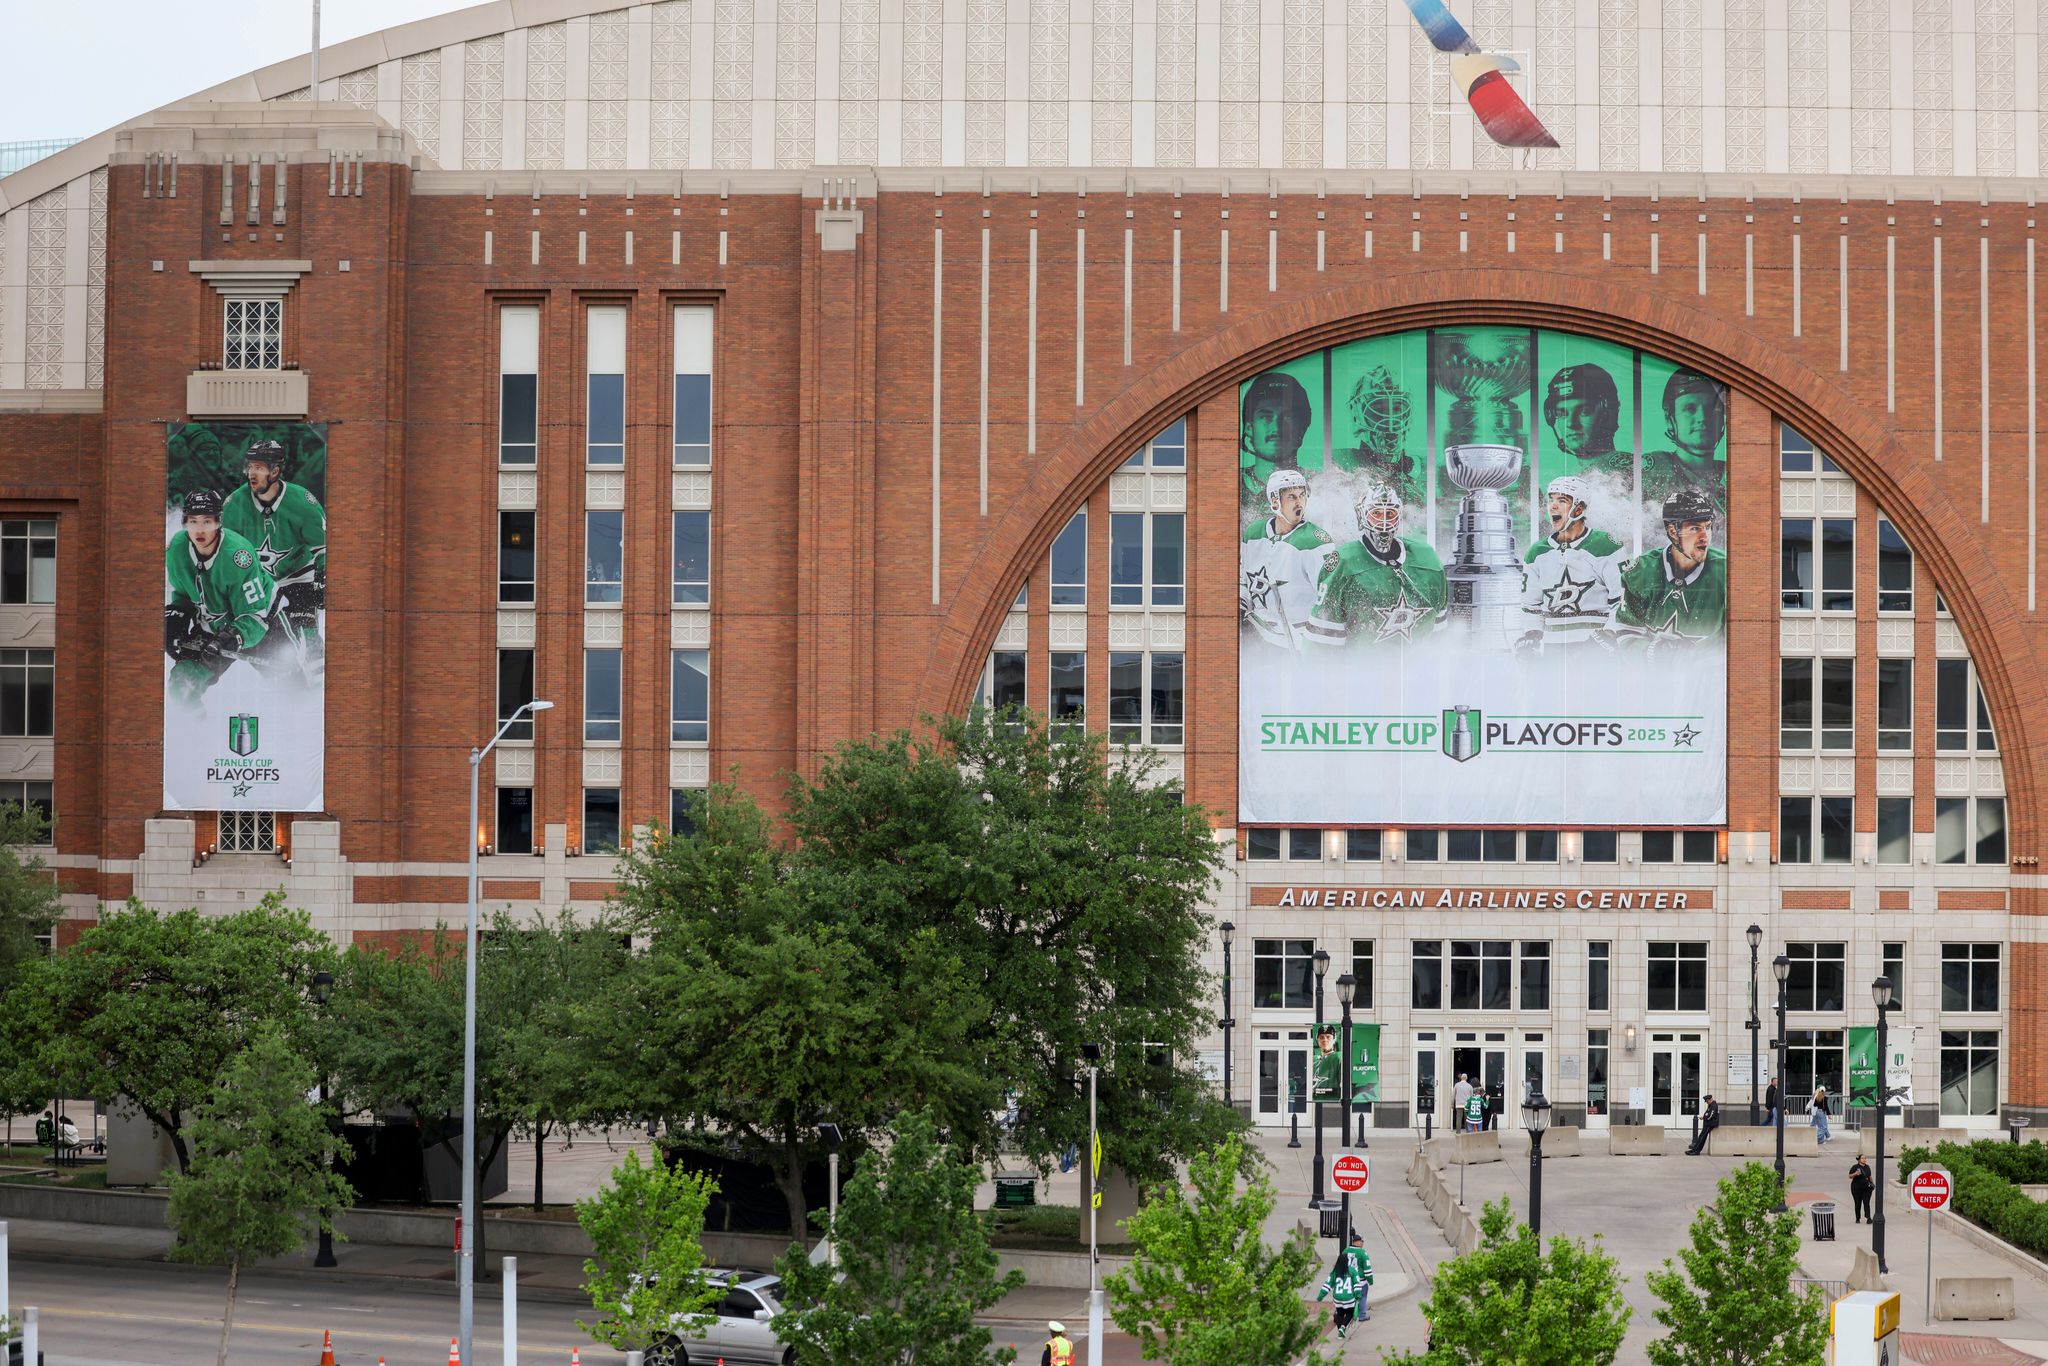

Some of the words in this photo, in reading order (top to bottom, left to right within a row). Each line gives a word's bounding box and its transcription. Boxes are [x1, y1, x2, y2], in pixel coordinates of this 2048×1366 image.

[242, 577, 266, 605] 21
[1261, 722, 1379, 745] STANLEY
[1386, 722, 1438, 746] CUP
[1486, 722, 1623, 746] PLAYOFFS
[1627, 728, 1666, 741] 2025
[214, 758, 253, 768] STANLEY
[255, 758, 273, 768] CUP
[206, 767, 280, 782] PLAYOFFS
[1278, 887, 1425, 908] AMERICAN
[1436, 888, 1567, 909] AIRLINES
[1576, 889, 1689, 910] CENTER
[1338, 1161, 1348, 1169] DO
[1339, 1179, 1361, 1187] ENTER
[1335, 1277, 1352, 1294] 24
